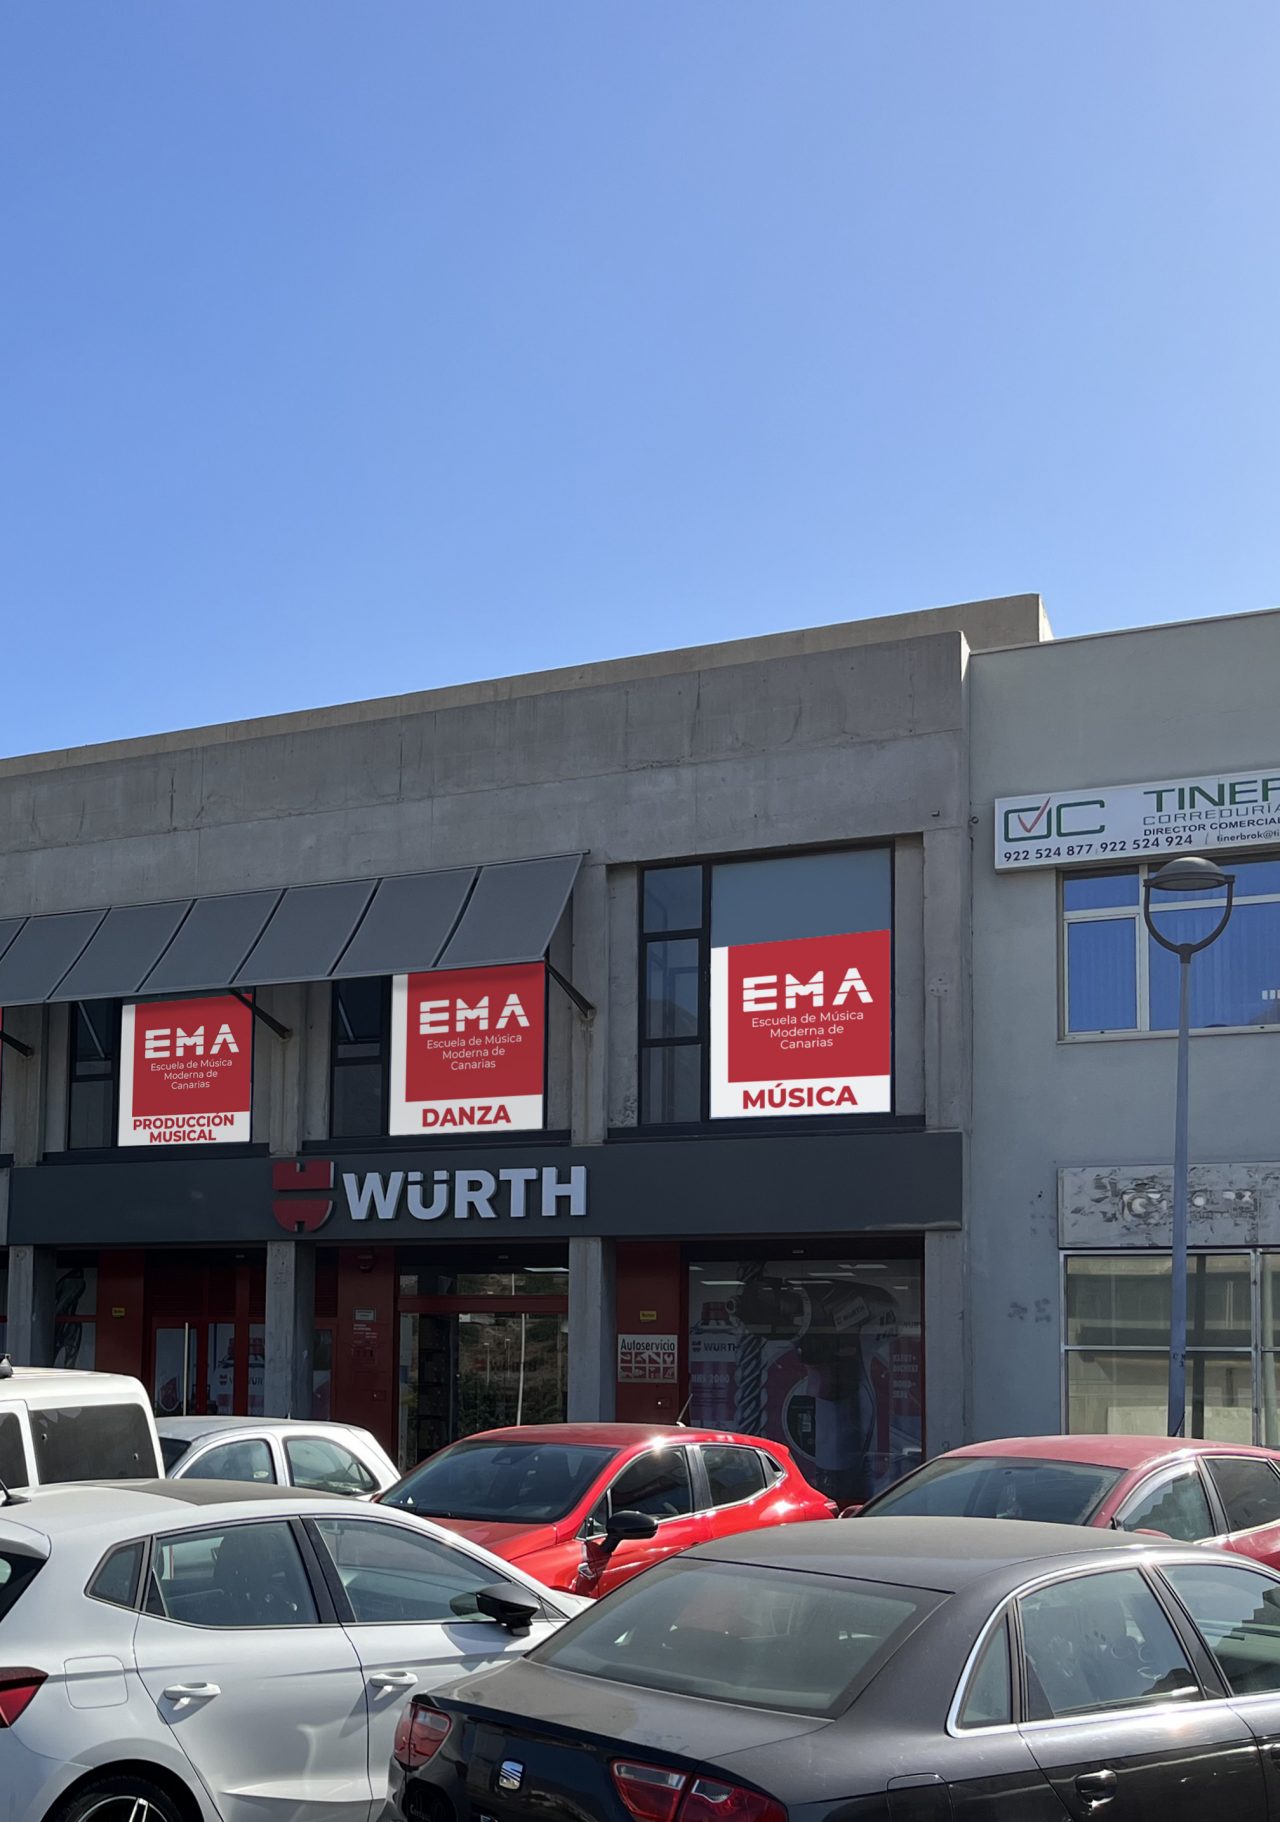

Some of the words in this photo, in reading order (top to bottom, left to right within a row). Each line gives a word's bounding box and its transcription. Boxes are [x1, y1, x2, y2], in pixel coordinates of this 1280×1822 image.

[1144, 823, 1206, 836] DIRECTOR
[1004, 850, 1029, 862] 922
[1035, 847, 1061, 859] 524
[1067, 844, 1093, 856] 877
[1100, 841, 1126, 853] 922
[1132, 837, 1160, 850] 524
[1165, 834, 1193, 847] 924
[742, 967, 874, 1012] EMA
[419, 993, 531, 1035] EMA
[752, 1015, 797, 1028] Escuela
[800, 1012, 816, 1024] de
[820, 1009, 864, 1022] Música
[769, 1026, 825, 1039] Moderna
[827, 1023, 844, 1035] de
[144, 1023, 240, 1059] EMA
[426, 1038, 466, 1049] Escuela
[469, 1036, 483, 1046] de
[485, 1033, 523, 1045] Música
[780, 1036, 834, 1050] Canarias
[442, 1048, 489, 1060] Moderna
[491, 1046, 506, 1056] de
[150, 1061, 184, 1072] Escuela
[186, 1060, 198, 1069] de
[200, 1058, 233, 1068] Música
[450, 1058, 496, 1071] Canarias
[164, 1071, 204, 1080] Moderna
[206, 1069, 218, 1078] de
[171, 1080, 211, 1090] Canarias
[742, 1083, 858, 1110] MÚSICA
[133, 1113, 234, 1130] PRODUCCIÓN
[421, 1104, 512, 1128] DANZA
[149, 1129, 217, 1143] MUSICAL
[342, 1166, 587, 1221] WÜRTH
[620, 1338, 675, 1351] Autoservicio
